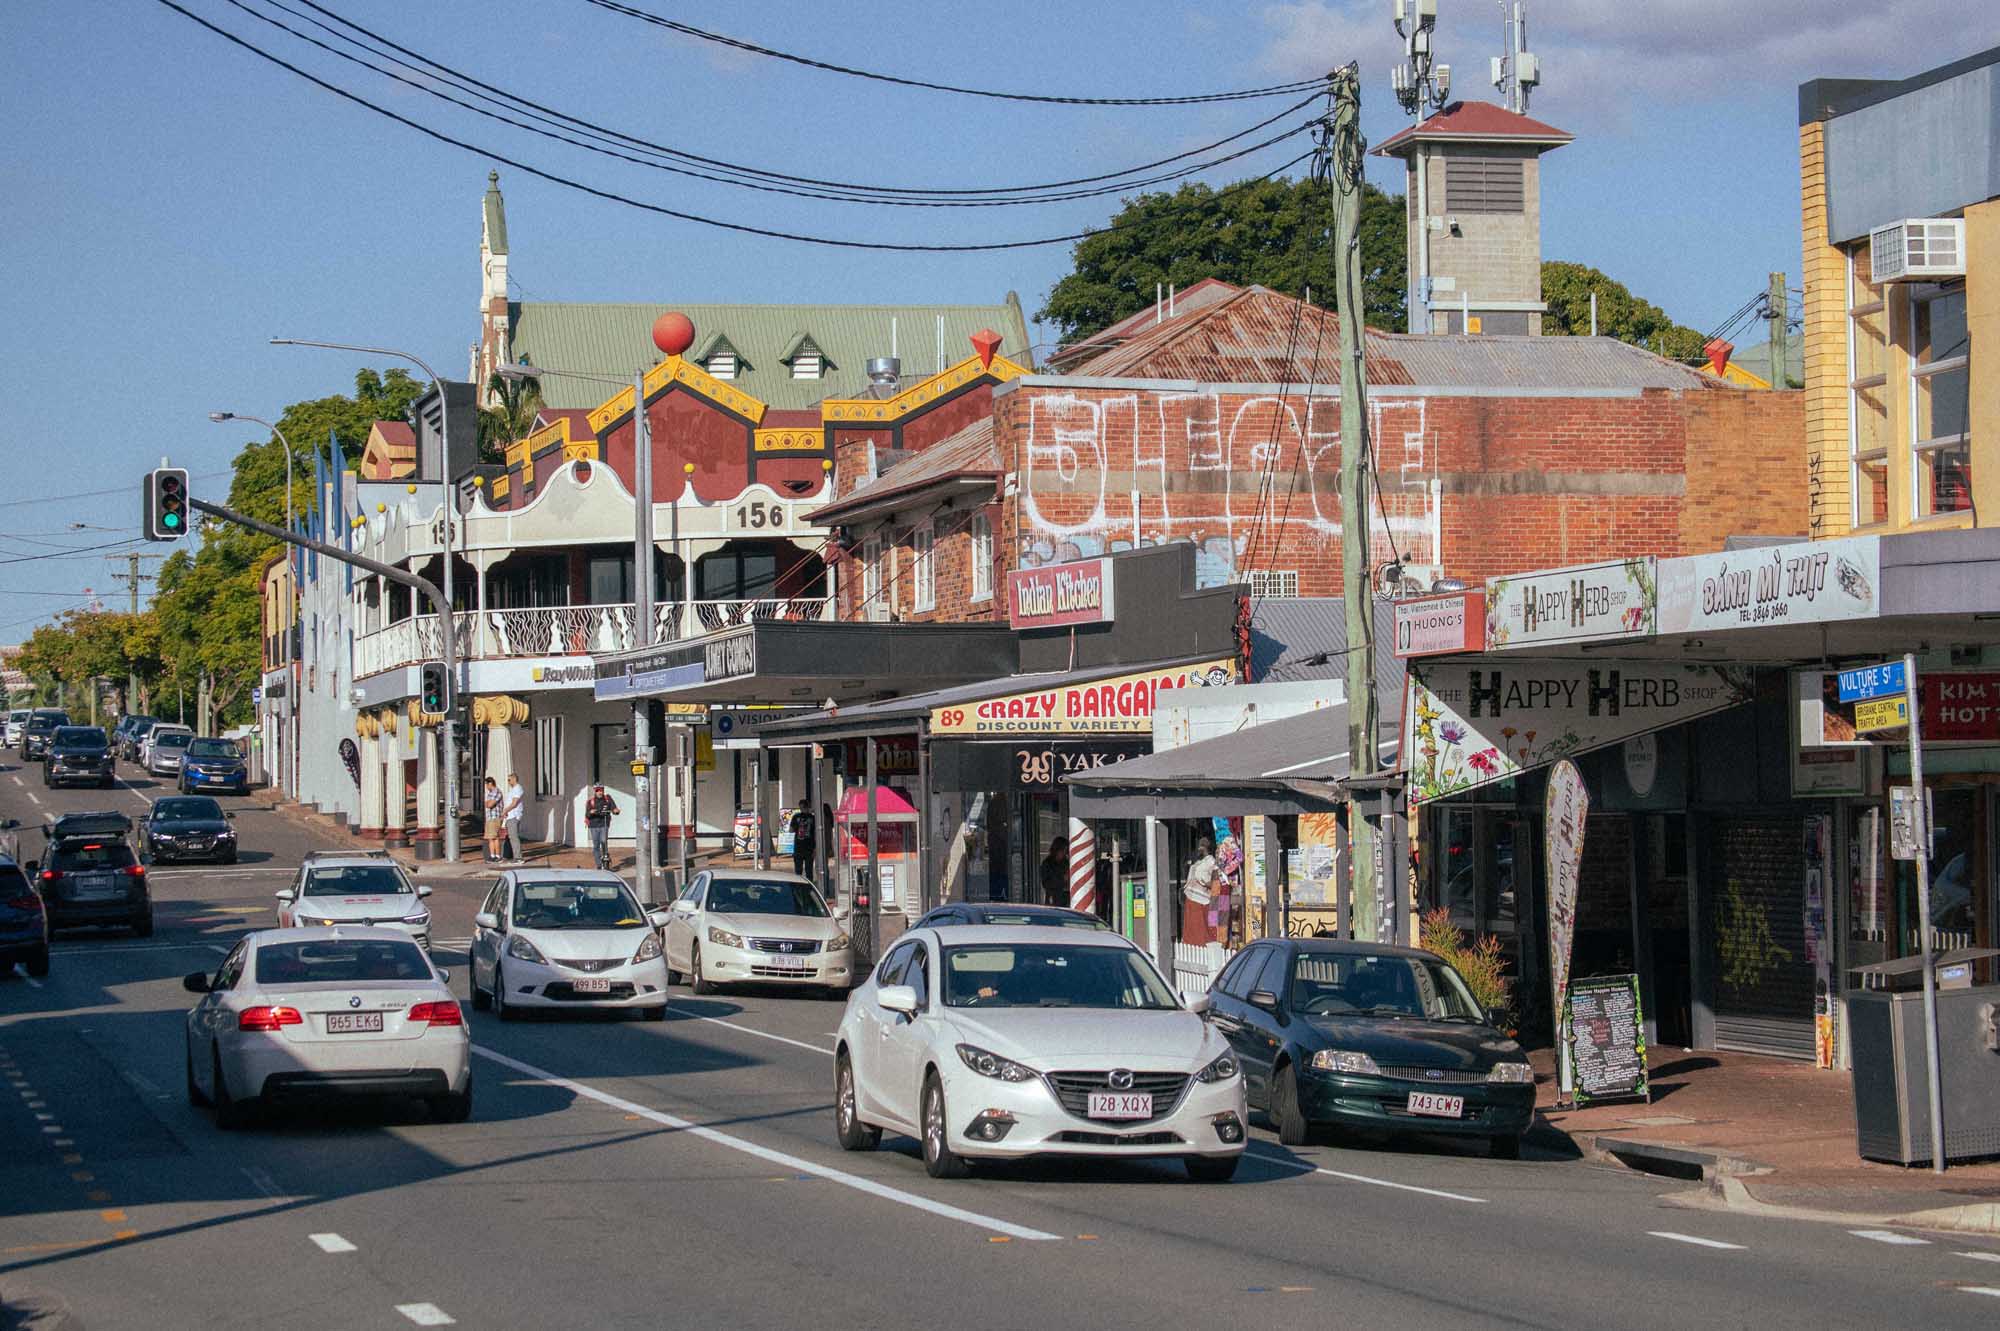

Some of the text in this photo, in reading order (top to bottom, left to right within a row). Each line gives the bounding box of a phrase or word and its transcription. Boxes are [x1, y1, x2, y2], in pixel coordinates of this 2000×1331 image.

[738, 502, 783, 528] 156
[432, 519, 455, 545] 156
[1702, 549, 1828, 615] BÁNH MÌ THỊT
[1016, 569, 1099, 617] Indian Kitchen
[1510, 579, 1627, 633] THE HAPPY HERB SHOP
[1739, 603, 1788, 624] TEL: 3846 3660
[1414, 614, 1462, 630] HUONG'S
[1840, 669, 1879, 691] VULTURE
[1435, 669, 1717, 718] THE HAPPY HERB SHOP
[1940, 682, 1986, 700] KIM
[977, 693, 1057, 719] CRAZY
[1940, 705, 1990, 723] HOT
[940, 710, 965, 726] 89
[976, 720, 1140, 731] DISCOUNT VARIETY
[1876, 716, 1887, 726] AREA
[1060, 753, 1108, 770] YAK
[1560, 780, 1575, 849] HERB
[1135, 886, 1144, 898] P
[592, 980, 609, 989] 853
[330, 1017, 351, 1029] 965
